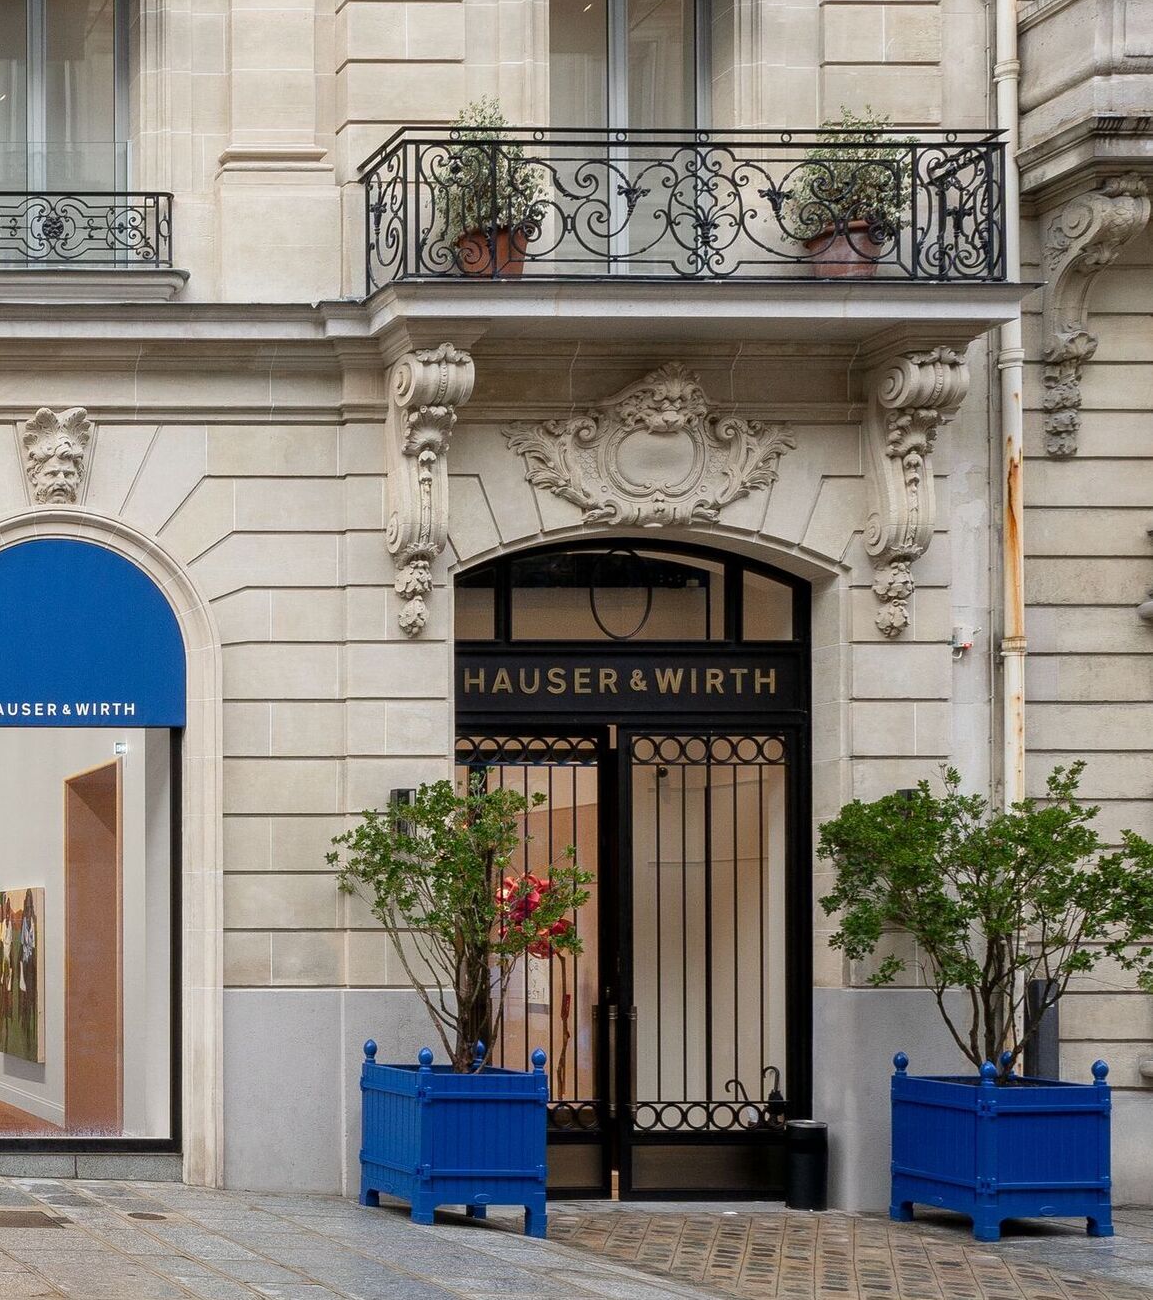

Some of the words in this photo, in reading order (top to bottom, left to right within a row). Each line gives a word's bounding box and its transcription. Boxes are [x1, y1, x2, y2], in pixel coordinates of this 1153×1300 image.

[464, 667, 618, 694] HAUSER
[629, 668, 648, 692] &
[654, 667, 777, 694] WIRTH
[62, 703, 72, 715] &
[75, 702, 135, 716] WIRTH
